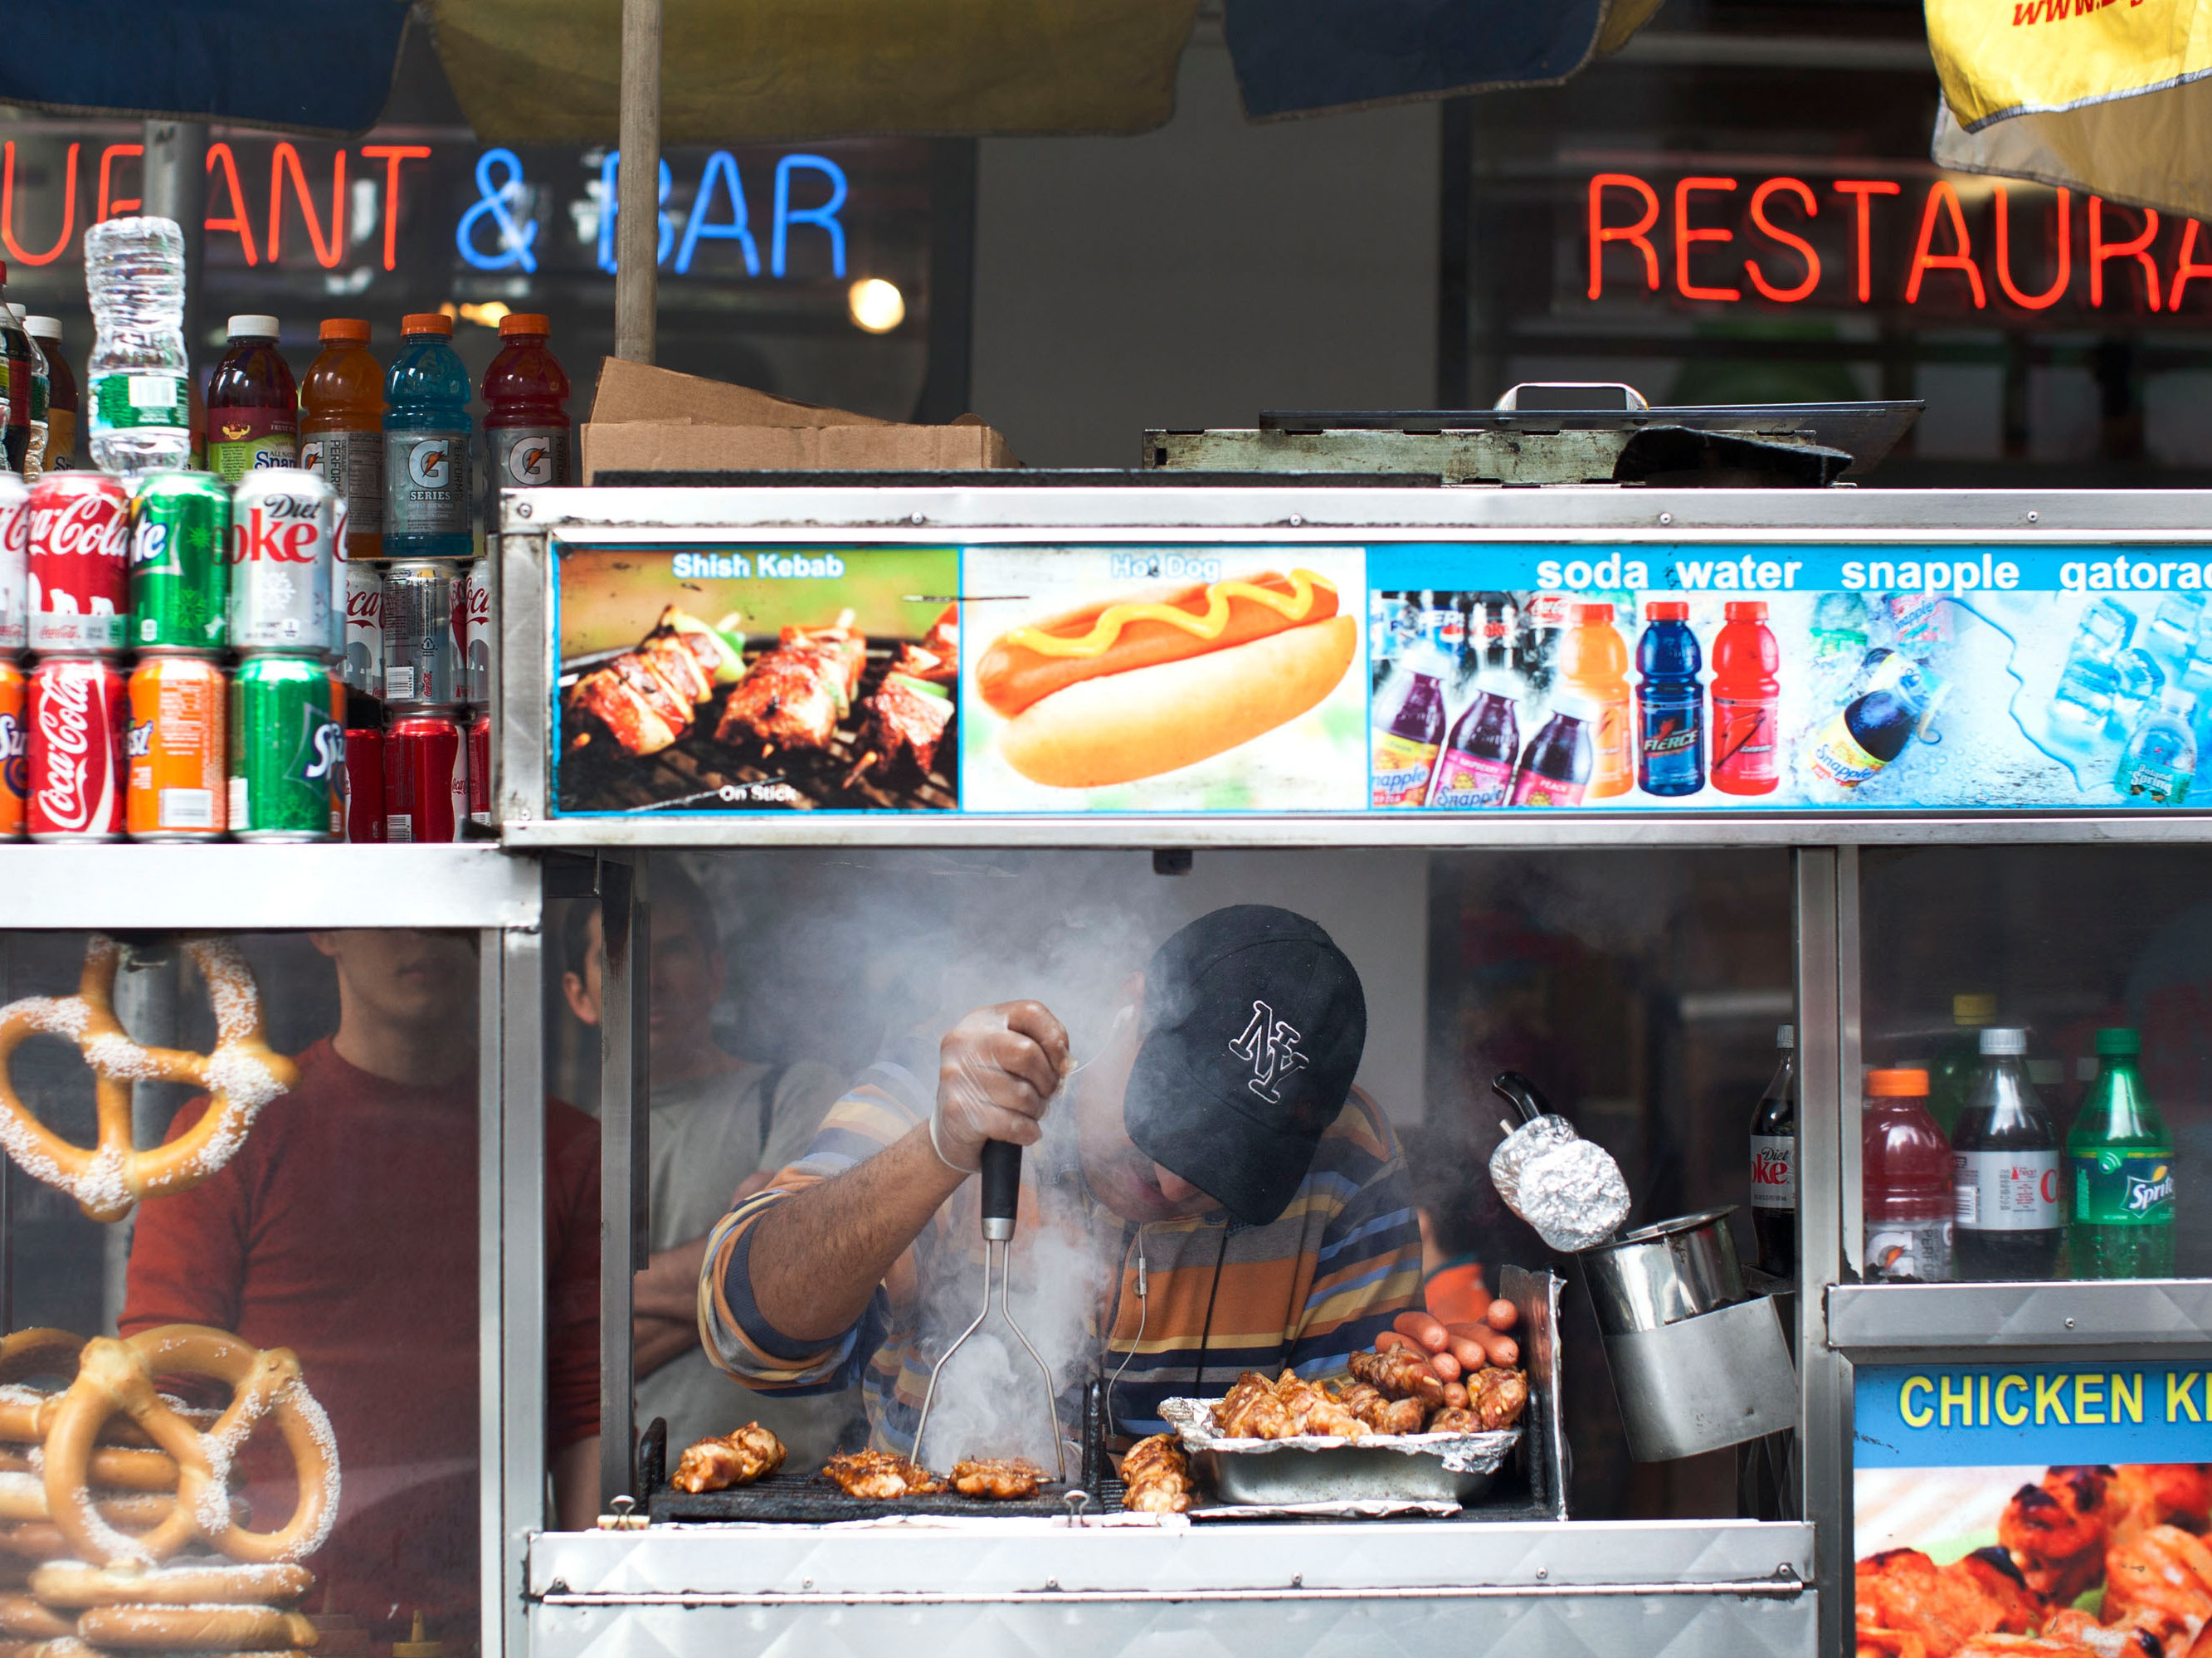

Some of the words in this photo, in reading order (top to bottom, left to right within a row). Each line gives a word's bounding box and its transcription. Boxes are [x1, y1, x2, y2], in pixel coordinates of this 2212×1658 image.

[456, 148, 539, 275] &
[264, 494, 321, 518] Diet
[411, 491, 451, 501] SERIES
[672, 553, 750, 578] Shish
[757, 553, 845, 578] Kebab
[1166, 554, 1221, 582] Dog
[1537, 553, 1649, 589] soda
[1676, 554, 1802, 589] water
[1841, 553, 2020, 597] snapple
[1644, 730, 1698, 751] FIERCE
[1815, 744, 1873, 780] Snapple
[719, 787, 748, 802] On
[751, 785, 797, 802] Stick
[1229, 1000, 1309, 1104] NY
[1761, 1146, 1789, 1161] Diet
[1899, 1373, 2144, 1427] CHICKEN
[2166, 1372, 2212, 1423] K
